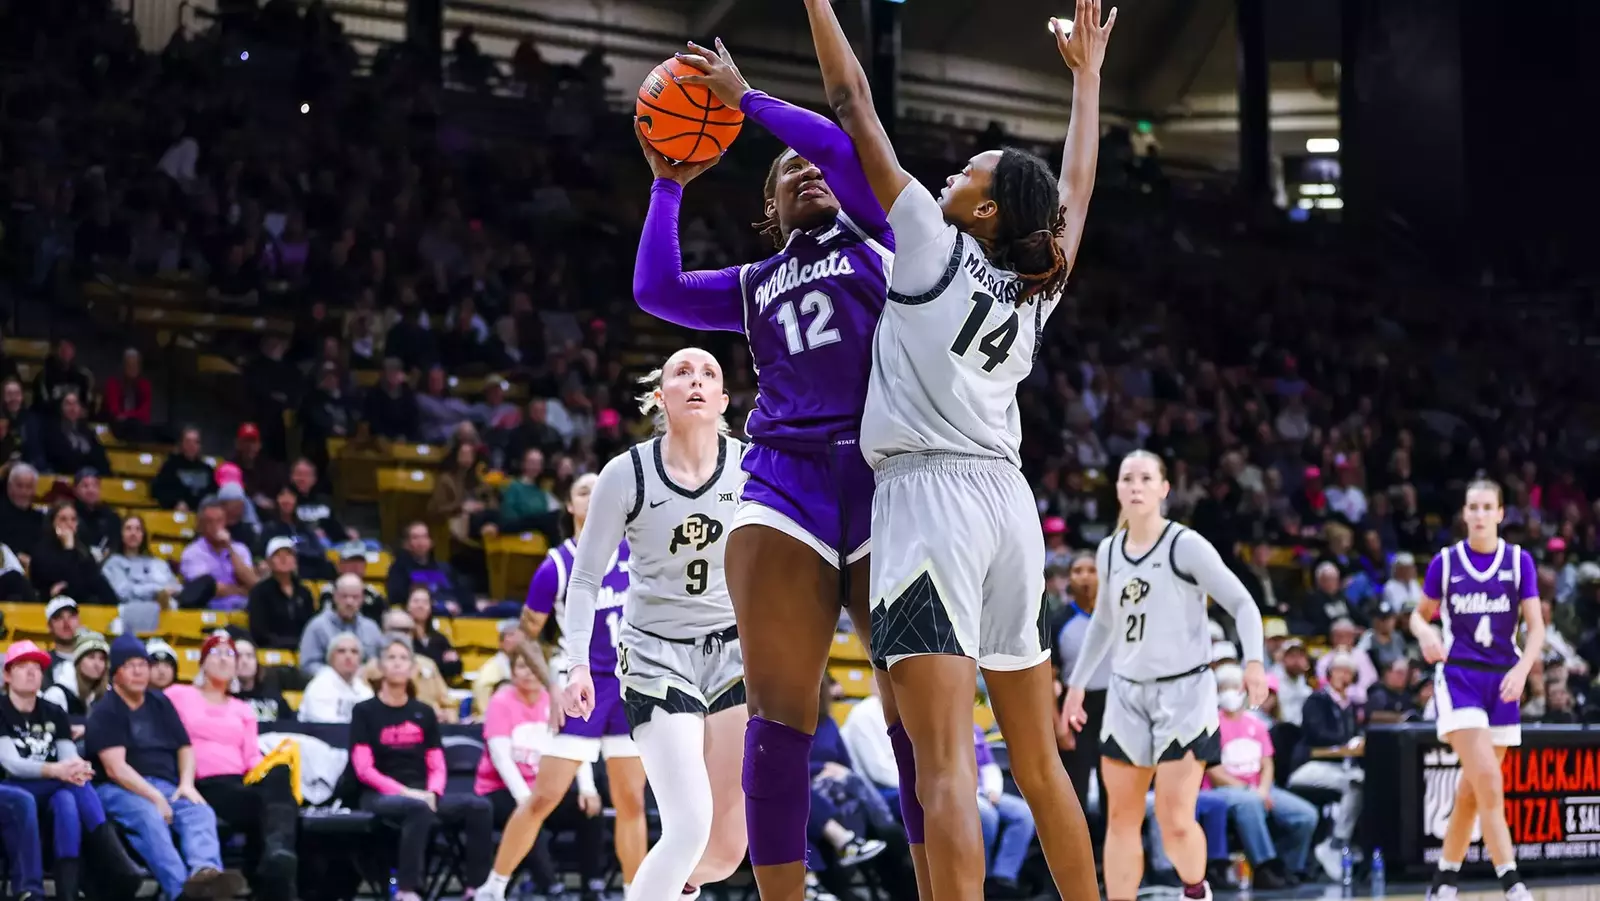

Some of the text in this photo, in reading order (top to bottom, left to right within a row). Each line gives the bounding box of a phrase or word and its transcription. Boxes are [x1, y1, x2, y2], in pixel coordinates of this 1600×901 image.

[755, 248, 856, 316] Wildcats
[776, 289, 842, 356] 12
[949, 290, 1020, 374] 14
[718, 492, 734, 502] XII
[685, 558, 709, 597] 9
[1450, 591, 1511, 615] Wildcats
[1126, 612, 1146, 643] 21
[1474, 614, 1493, 648] 4
[1501, 748, 1600, 793] BLACKJA
[1565, 805, 1577, 833] &
